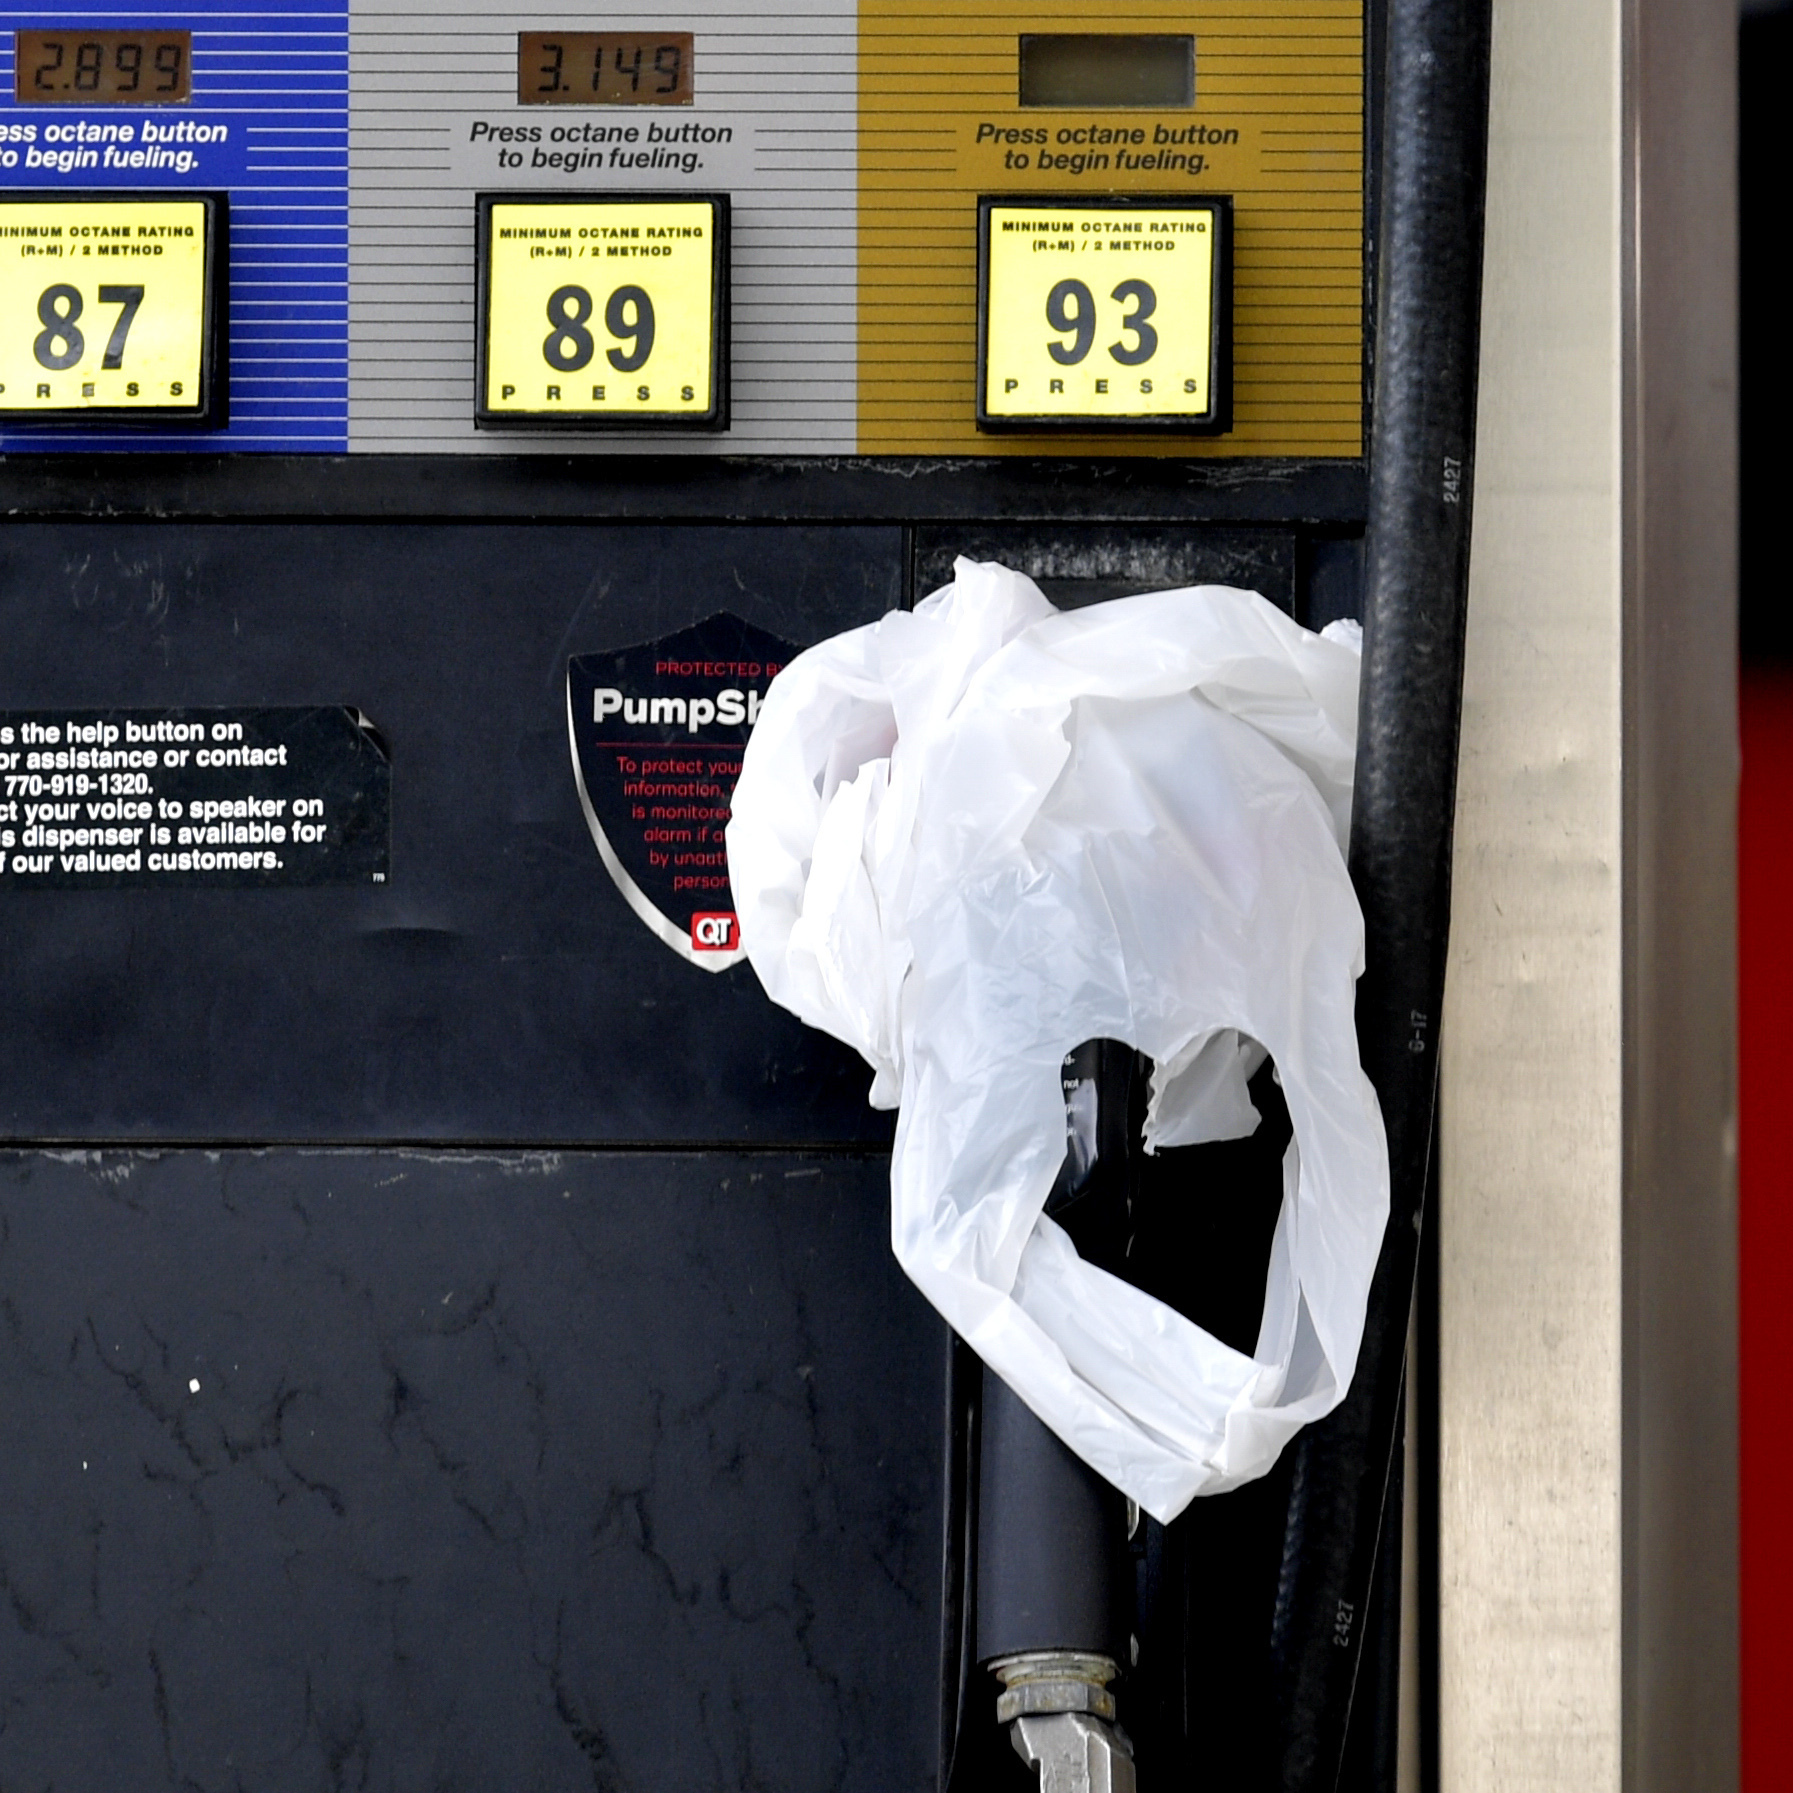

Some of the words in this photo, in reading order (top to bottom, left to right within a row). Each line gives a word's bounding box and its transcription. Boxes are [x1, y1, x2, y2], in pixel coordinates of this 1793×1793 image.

[34, 43, 183, 92] 2.899
[538, 44, 681, 93] 3.149
[45, 121, 134, 142] octane
[141, 120, 227, 142] button
[26, 146, 98, 172] begin
[104, 145, 198, 172] fueling.
[70, 227, 130, 237] OCTANE
[138, 227, 193, 237] RATING
[22, 245, 62, 256] (R+M)
[70, 246, 75, 255] /
[83, 246, 90, 255] 2
[98, 245, 163, 255] METHOD
[33, 283, 145, 371] 87
[542, 283, 655, 372] 89
[1045, 278, 1158, 366] 93
[501, 384, 695, 401] PRESS
[656, 662, 761, 676] PROTECTED
[593, 688, 764, 733] PumpSh
[21, 722, 60, 744] the
[67, 721, 119, 745] help
[126, 720, 204, 742] button
[212, 723, 242, 741] on
[27, 745, 157, 769] assistance
[164, 750, 190, 767] or
[196, 745, 287, 767] contact
[5, 772, 154, 796] 770-919-1320.
[624, 780, 725, 798] information,
[24, 803, 80, 825] your
[87, 798, 152, 820] voice
[158, 798, 182, 819] to
[190, 796, 286, 823] speaker
[293, 799, 323, 817] on
[22, 823, 143, 851] dispenser
[151, 823, 171, 845] is
[178, 820, 286, 844] available
[292, 821, 326, 842] for
[696, 917, 732, 946] QT
